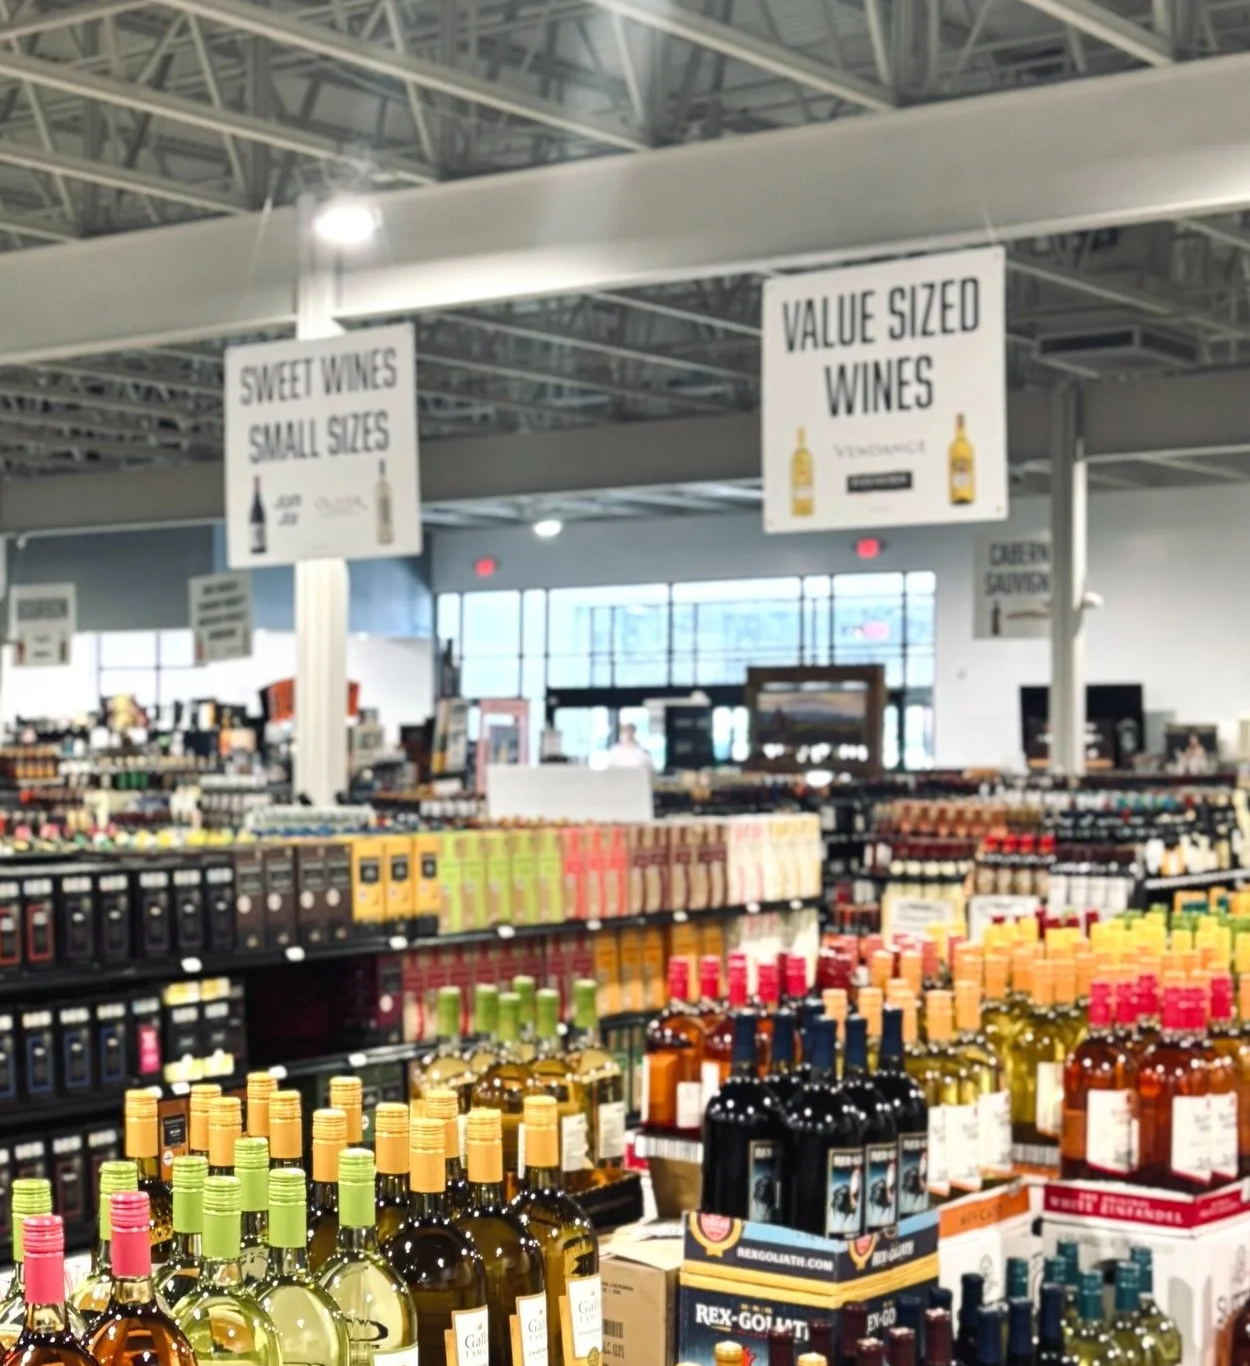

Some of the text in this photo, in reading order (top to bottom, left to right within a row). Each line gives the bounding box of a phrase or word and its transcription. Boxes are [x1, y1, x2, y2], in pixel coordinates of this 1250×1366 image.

[782, 276, 981, 353] VALUE SIZED
[240, 347, 397, 405] SWEET WINES
[824, 355, 935, 419] WINES
[249, 409, 390, 464] SMALL SIZES
[737, 1247, 834, 1272] REXGOLIATH.COM
